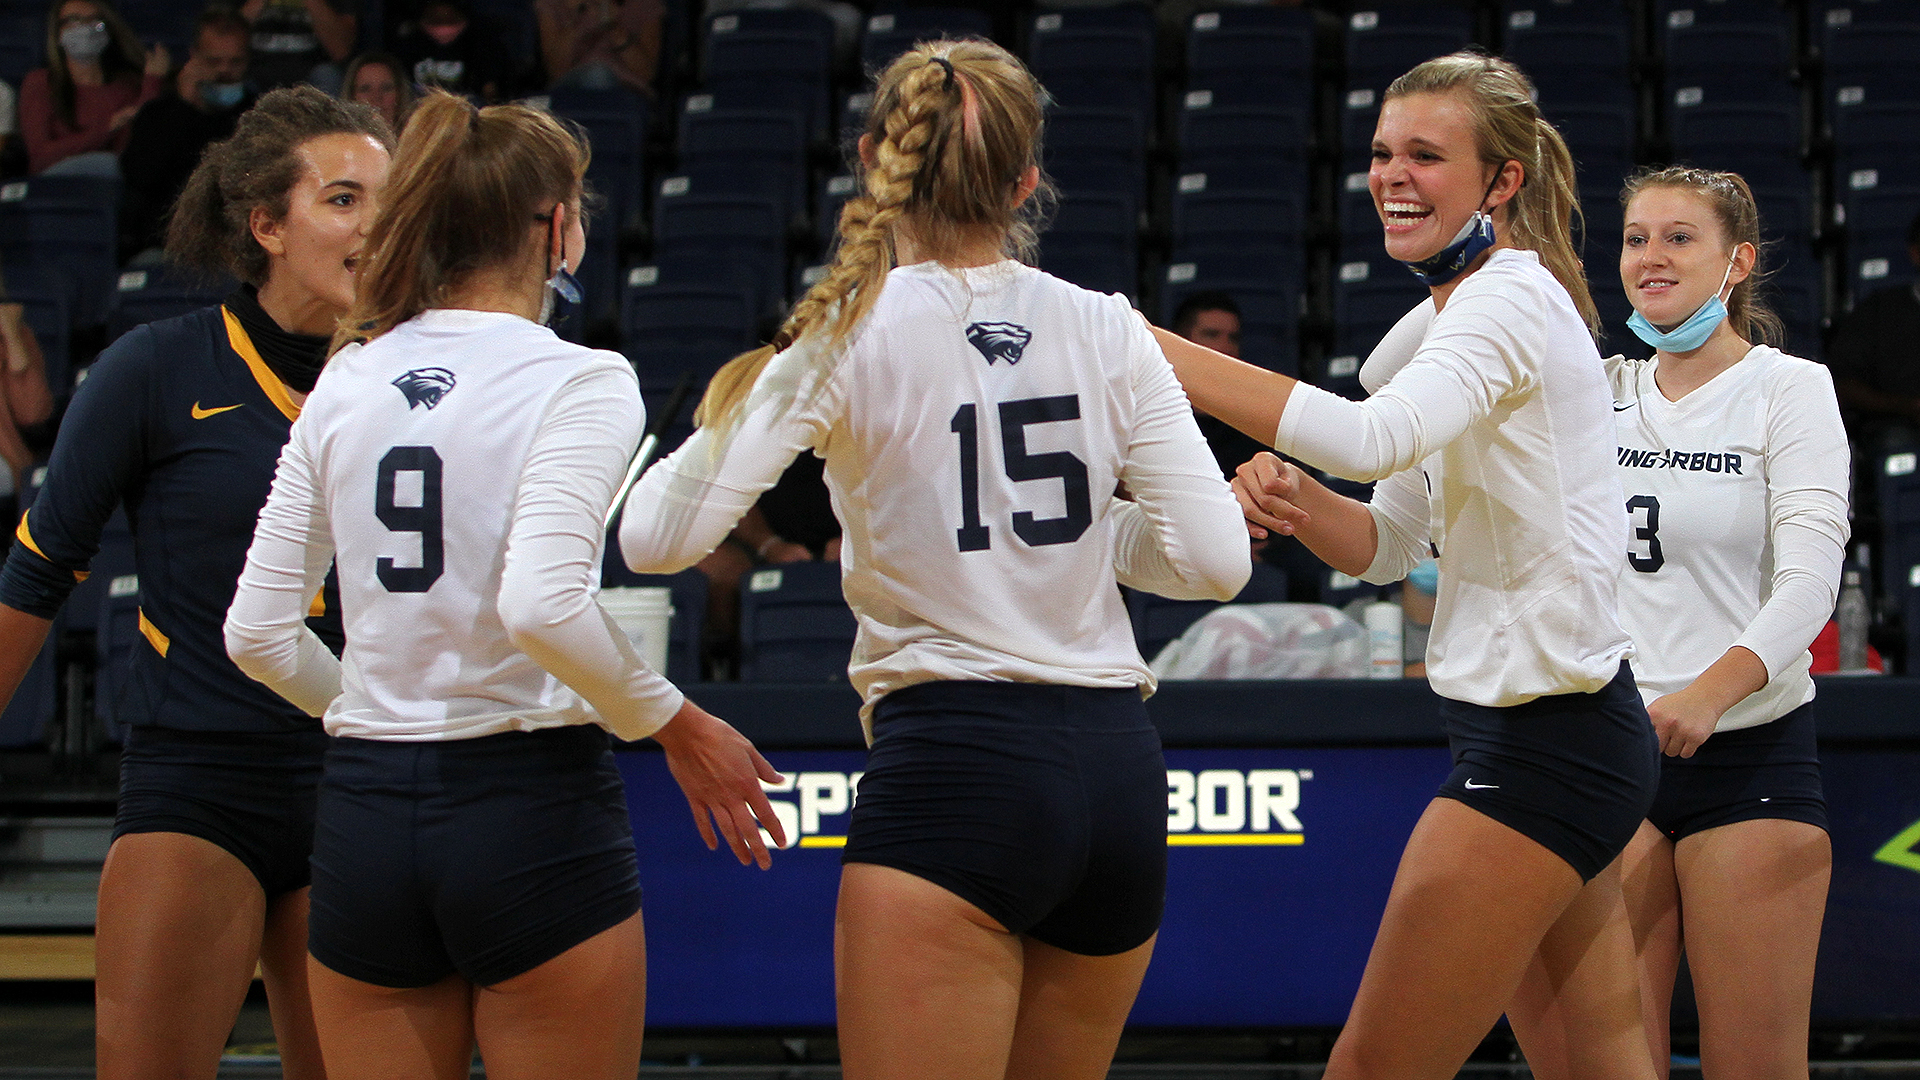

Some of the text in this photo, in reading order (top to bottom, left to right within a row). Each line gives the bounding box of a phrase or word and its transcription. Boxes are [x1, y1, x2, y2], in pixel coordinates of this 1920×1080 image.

[375, 446, 445, 592] 9
[951, 393, 1093, 552] 15
[1625, 495, 1665, 573] 3
[745, 771, 866, 850] SP
